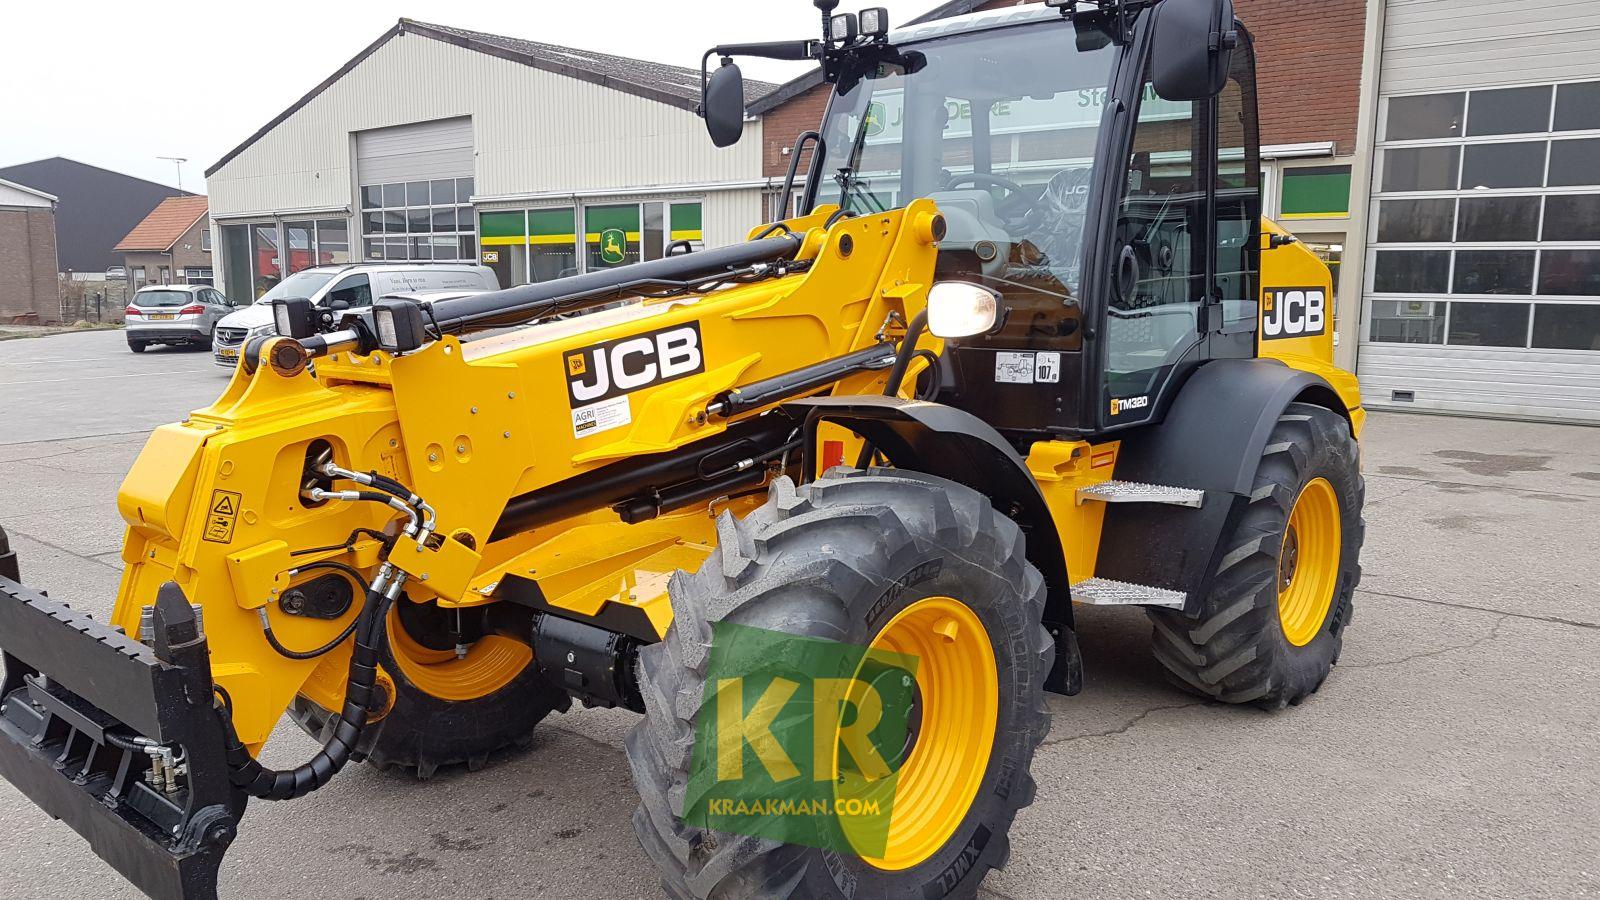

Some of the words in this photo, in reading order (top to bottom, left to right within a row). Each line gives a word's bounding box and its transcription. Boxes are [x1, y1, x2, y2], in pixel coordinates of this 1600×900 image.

[483, 252, 497, 261] JCB
[1264, 291, 1325, 336] JCB
[571, 327, 701, 401] JCB
[1038, 365, 1052, 380] 107
[1118, 396, 1148, 411] TM320
[575, 409, 595, 422] AGRI
